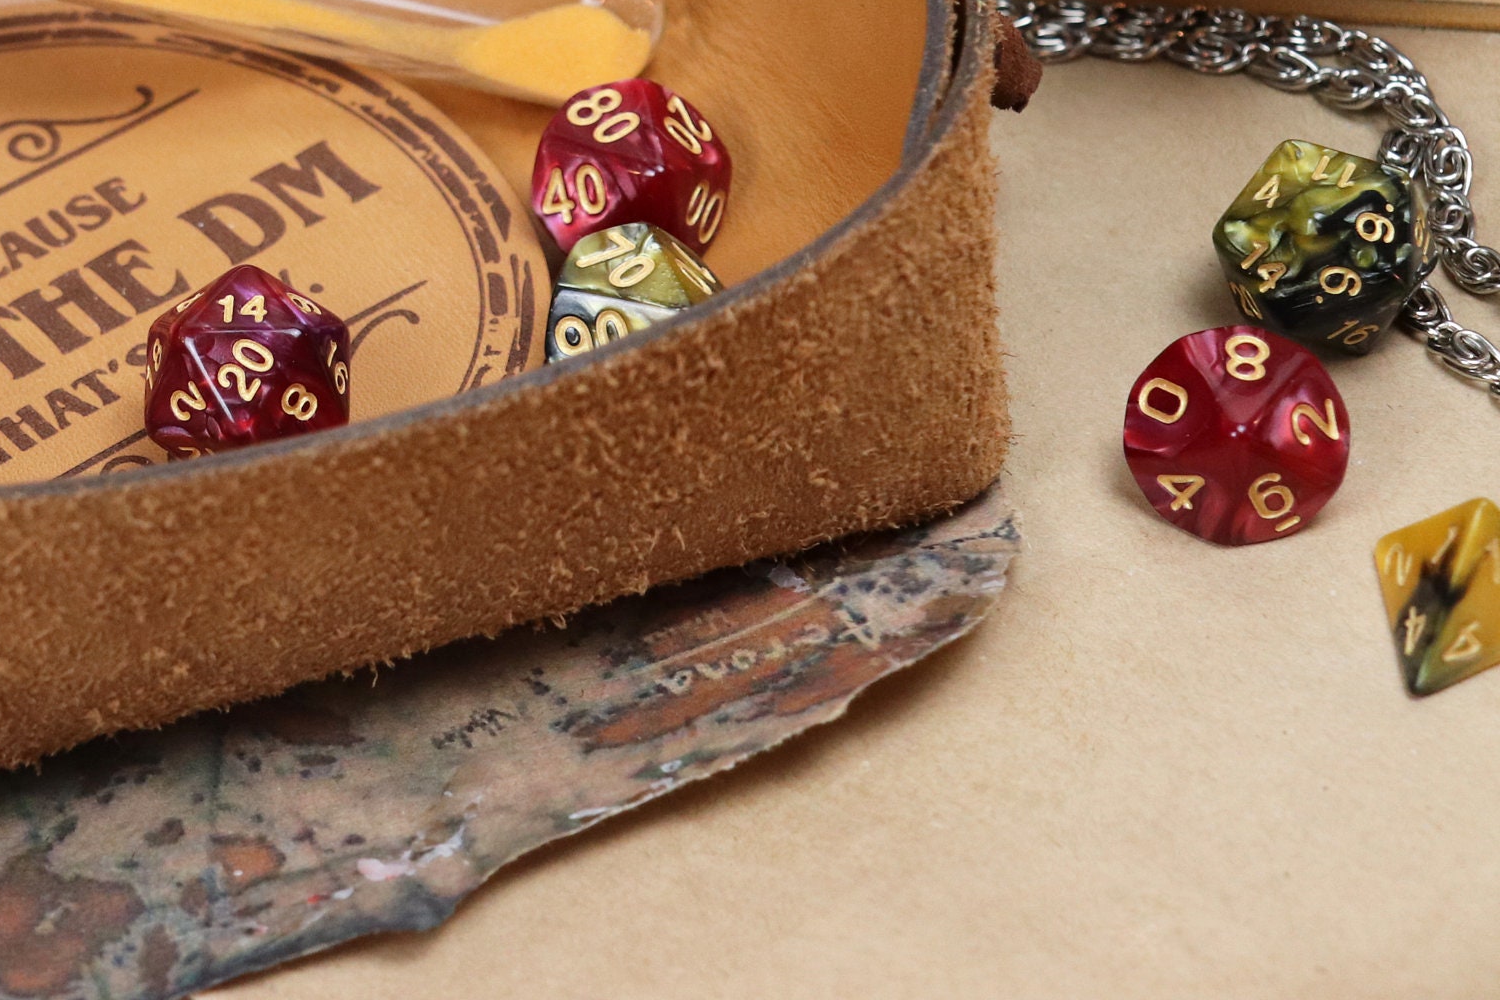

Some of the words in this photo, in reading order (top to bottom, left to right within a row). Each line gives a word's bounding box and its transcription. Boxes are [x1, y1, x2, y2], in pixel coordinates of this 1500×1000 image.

[566, 88, 641, 144] 80
[663, 95, 713, 155] 20
[542, 163, 608, 224] 40
[1253, 174, 1282, 208] 4
[1311, 155, 1357, 188] 11
[177, 140, 383, 266] DM
[686, 180, 726, 244] 00
[575, 230, 656, 288] 70
[1241, 240, 1288, 294] 14
[218, 294, 268, 323] 14
[1326, 319, 1381, 345] 16
[217, 338, 274, 402] 20
[1225, 334, 1270, 382] 8
[170, 380, 207, 421] 2
[281, 383, 318, 421] 8
[1138, 377, 1189, 424] 0
[1290, 398, 1341, 446] 2
[1157, 473, 1206, 512] 4
[1384, 543, 1413, 587] 2
[1430, 526, 1458, 565] 1
[1404, 606, 1428, 656] 4
